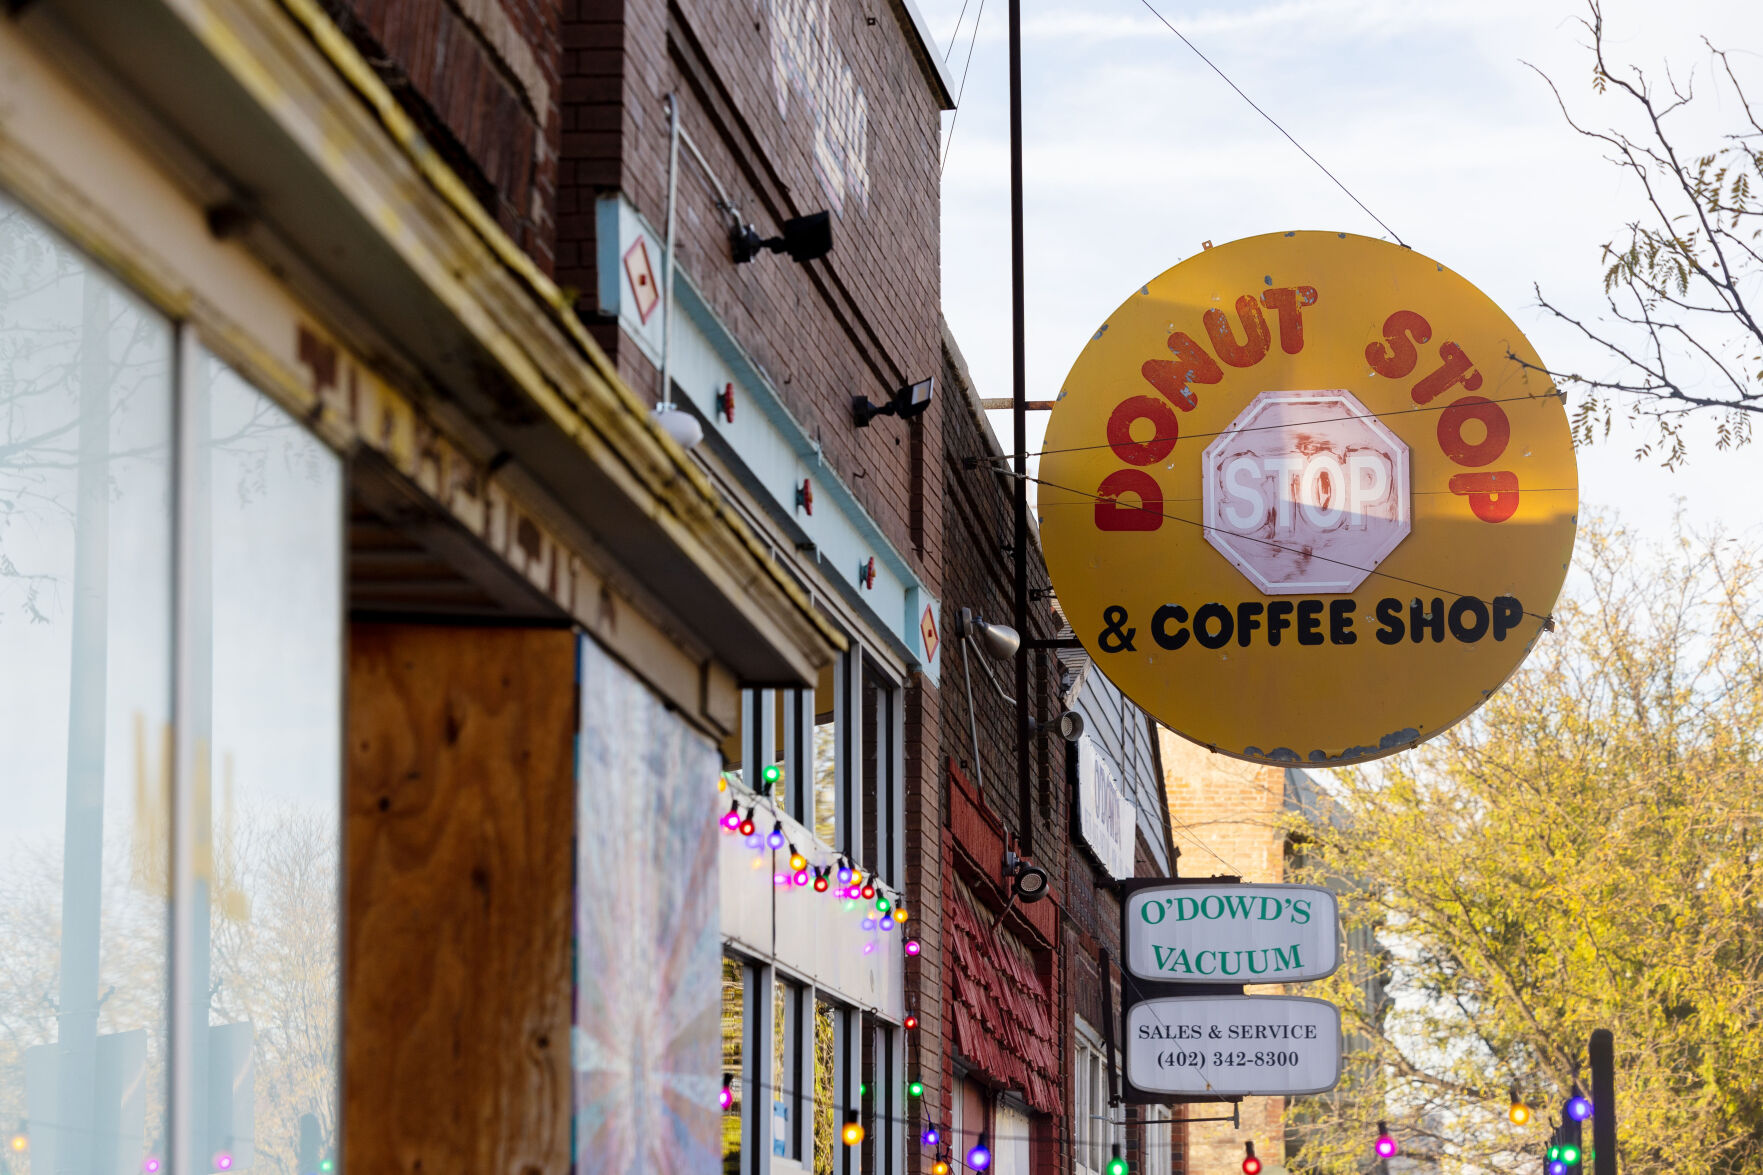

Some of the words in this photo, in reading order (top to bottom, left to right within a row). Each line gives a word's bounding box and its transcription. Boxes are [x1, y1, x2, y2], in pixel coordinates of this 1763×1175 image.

[1094, 285, 1318, 531] DONUT
[1364, 310, 1520, 523] STOP
[1224, 455, 1388, 532] STOP
[1097, 604, 1137, 653] &
[1150, 600, 1358, 651] COFFEE
[1375, 596, 1523, 646] SHOP
[1141, 895, 1312, 925] O'DOWD'S
[1151, 944, 1305, 975] VACUUM
[1138, 1024, 1202, 1040] SALES
[1208, 1025, 1223, 1039] &
[1228, 1024, 1317, 1040] SERVICE
[1157, 1051, 1206, 1069] (402)
[1213, 1051, 1299, 1067] 342-8300
